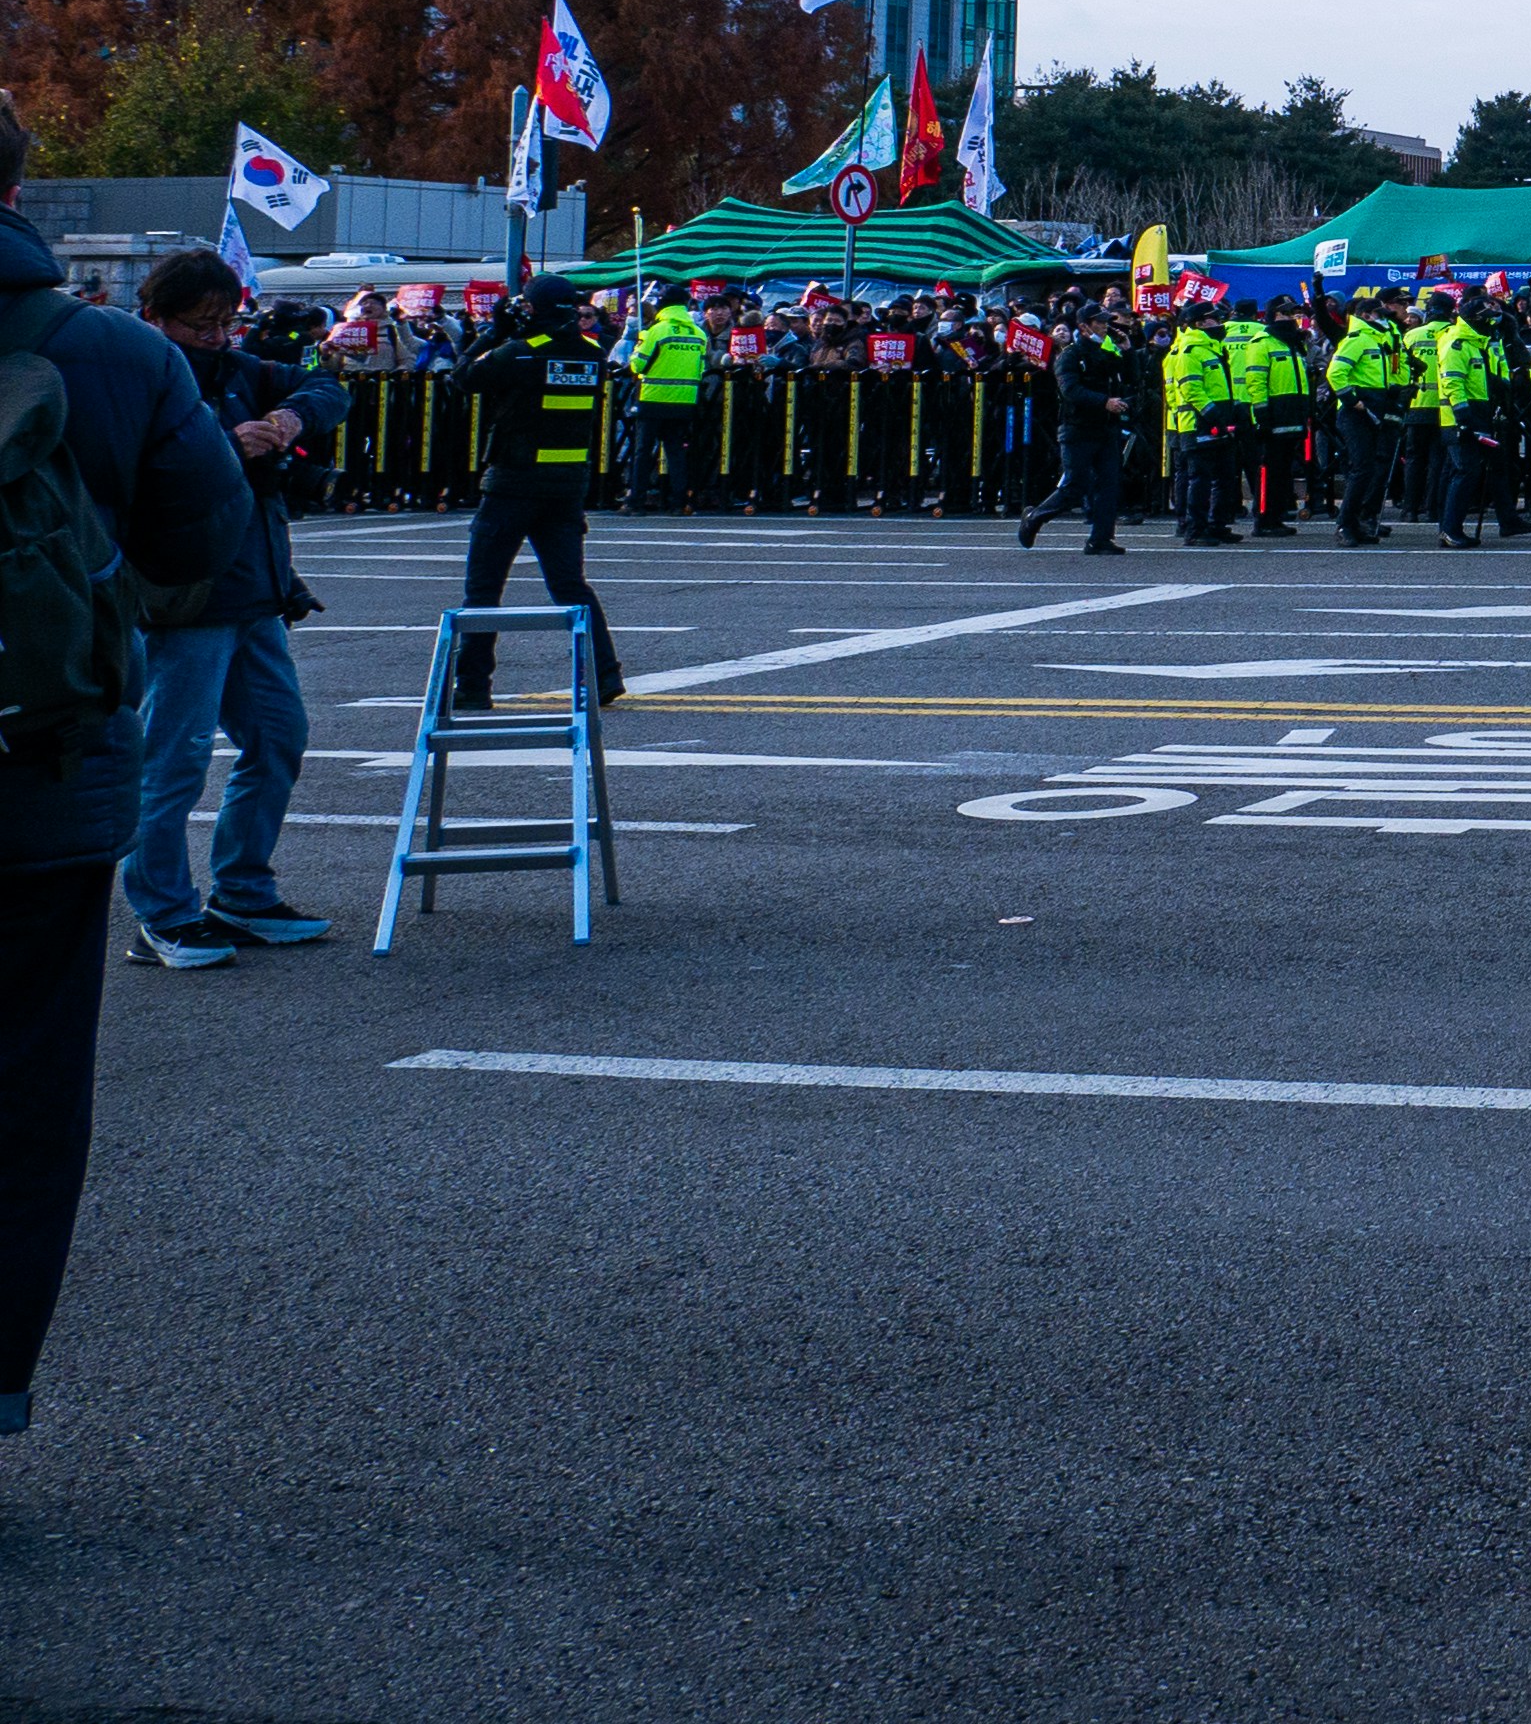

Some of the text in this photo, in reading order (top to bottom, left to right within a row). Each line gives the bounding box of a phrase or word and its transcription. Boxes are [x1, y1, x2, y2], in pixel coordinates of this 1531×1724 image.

[1183, 279, 1218, 302] 탄핵
[1137, 291, 1170, 312] 탄핵
[552, 374, 594, 385] POLICE
